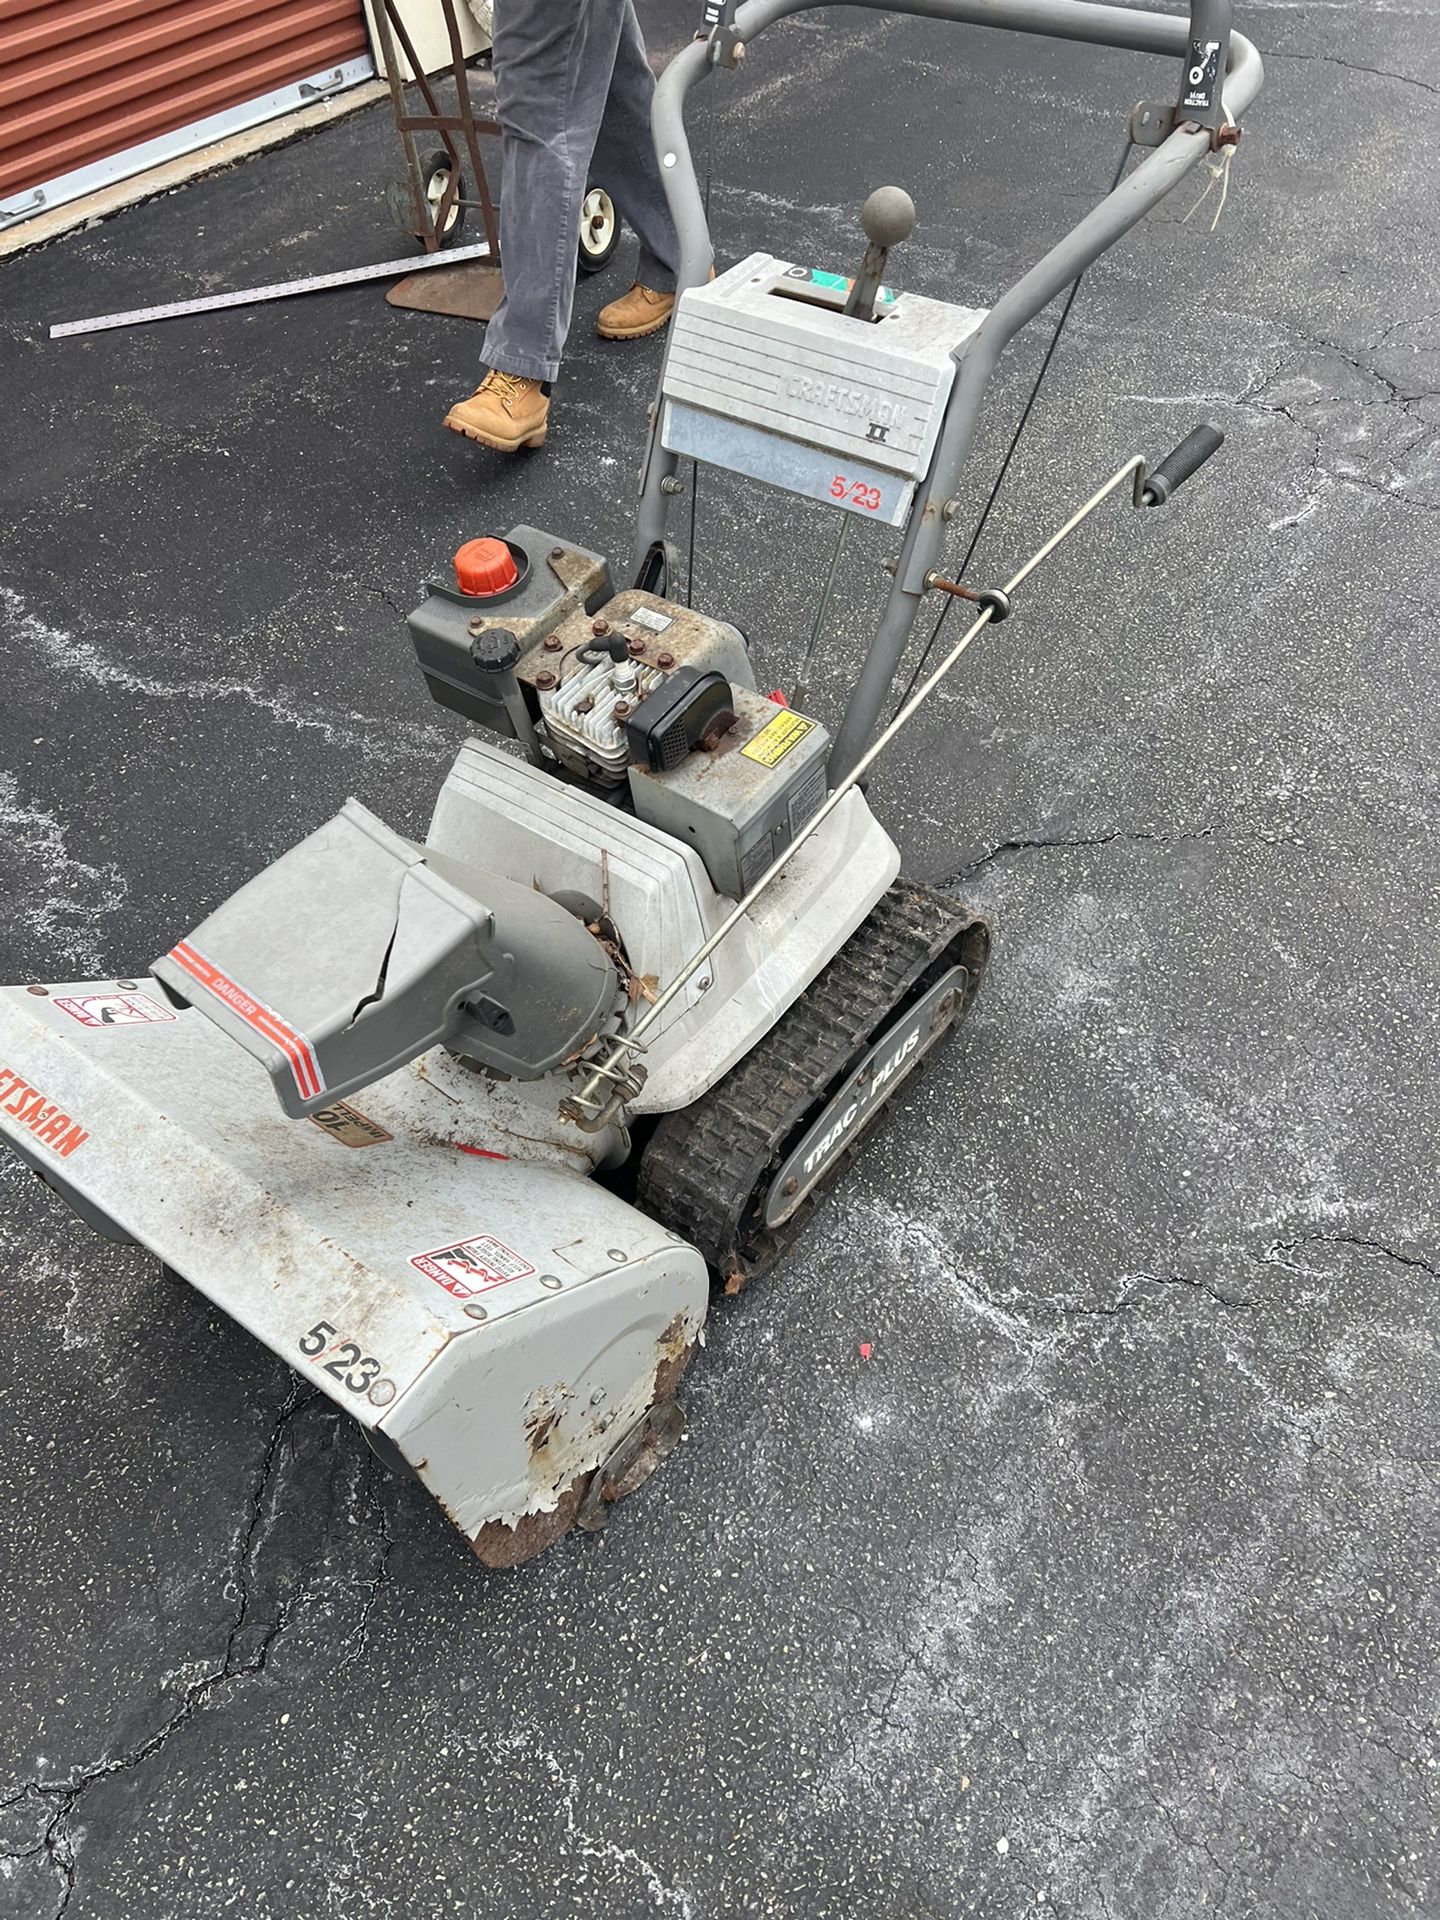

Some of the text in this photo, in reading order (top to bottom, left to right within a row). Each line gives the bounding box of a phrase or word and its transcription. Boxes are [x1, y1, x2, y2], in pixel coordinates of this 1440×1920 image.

[786, 374, 907, 430] CRAFTSMAN
[829, 475, 881, 511] 5/23
[212, 978, 257, 1016] DANGER
[415, 1257, 452, 1286] DANGER
[299, 1320, 381, 1394] 5/23
